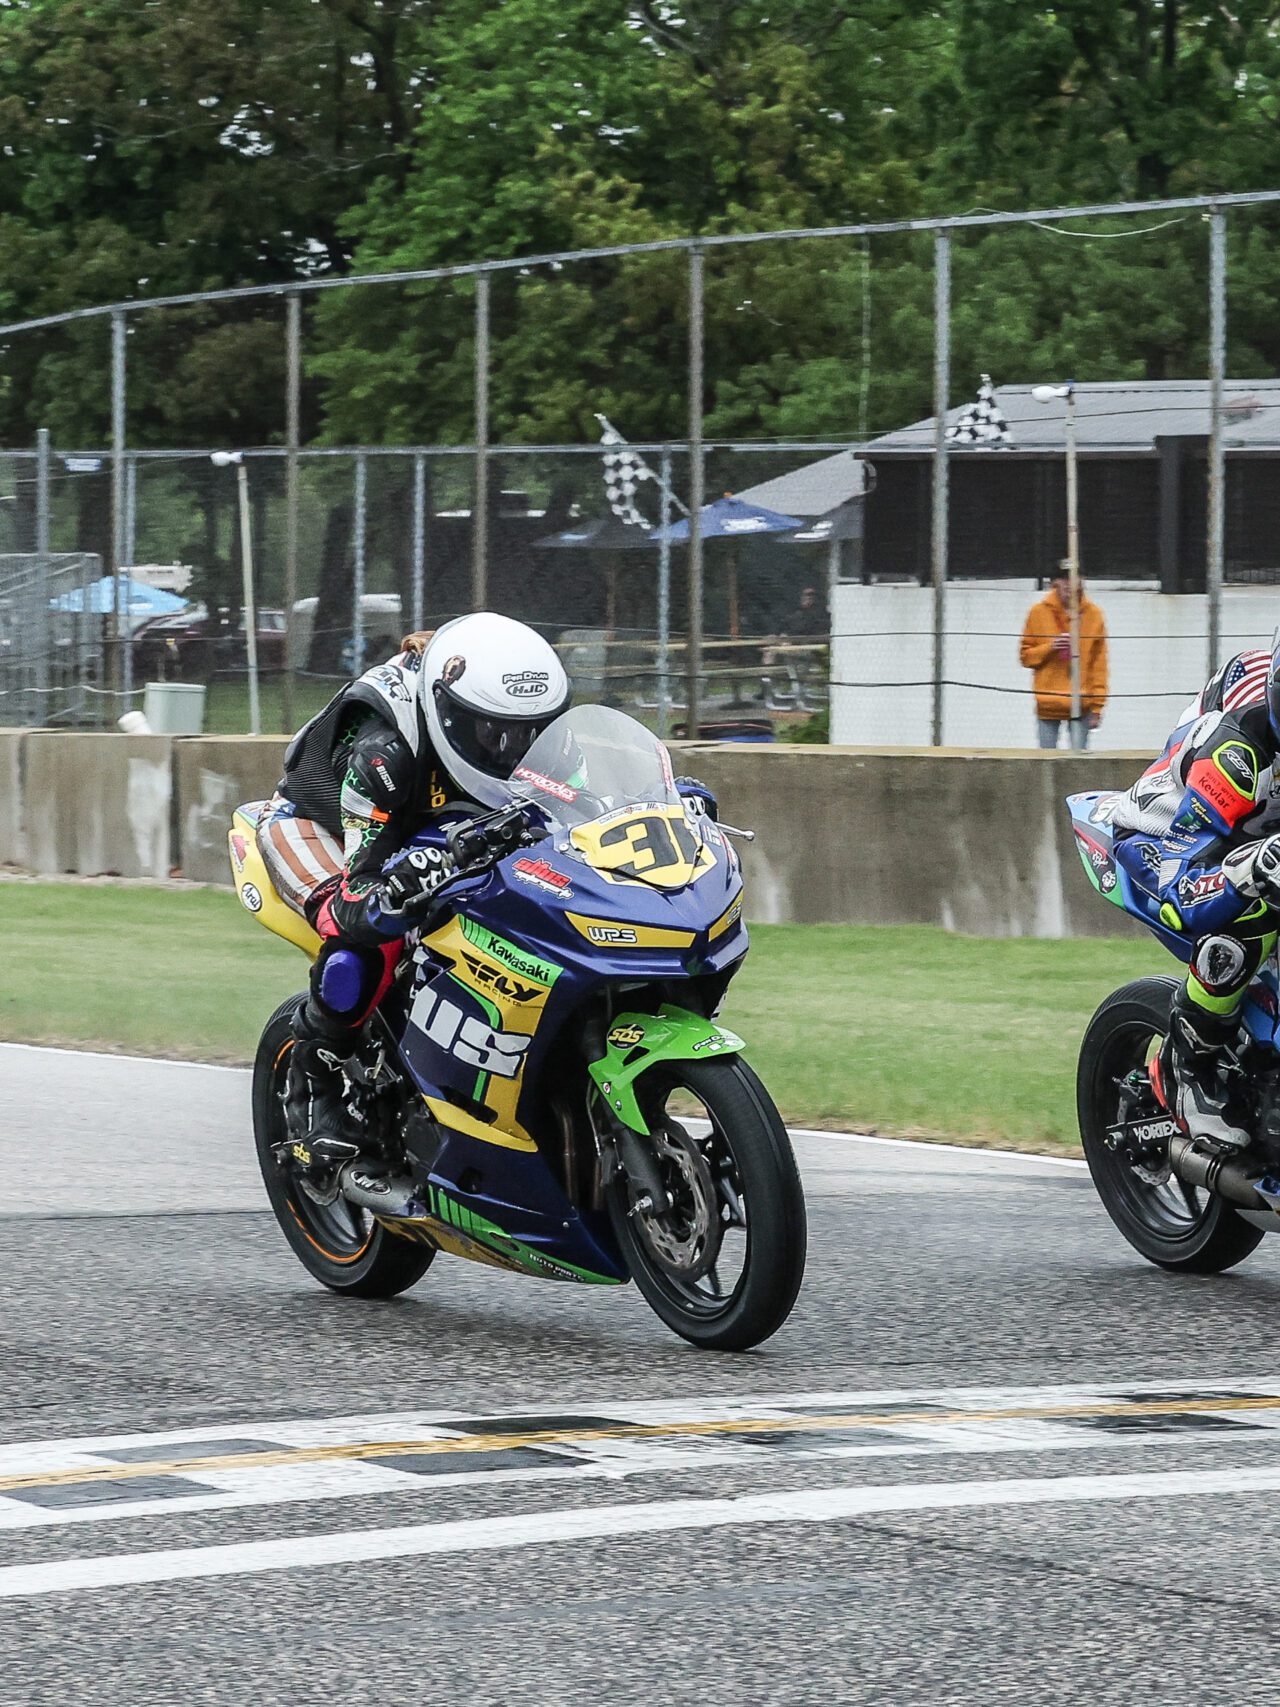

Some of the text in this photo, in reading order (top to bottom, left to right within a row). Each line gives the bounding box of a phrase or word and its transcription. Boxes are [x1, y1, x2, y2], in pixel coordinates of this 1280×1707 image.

[511, 684, 545, 695] HJC
[375, 764, 396, 792] BISON
[1221, 749, 1255, 784] RST
[1199, 776, 1230, 809] Kevlar
[242, 886, 262, 909] Arai
[588, 926, 637, 944] WPS
[488, 936, 551, 983] Kawasaki
[465, 954, 545, 1002] FLY
[474, 977, 523, 1008] RACING
[1133, 1120, 1183, 1143] VORTEX
